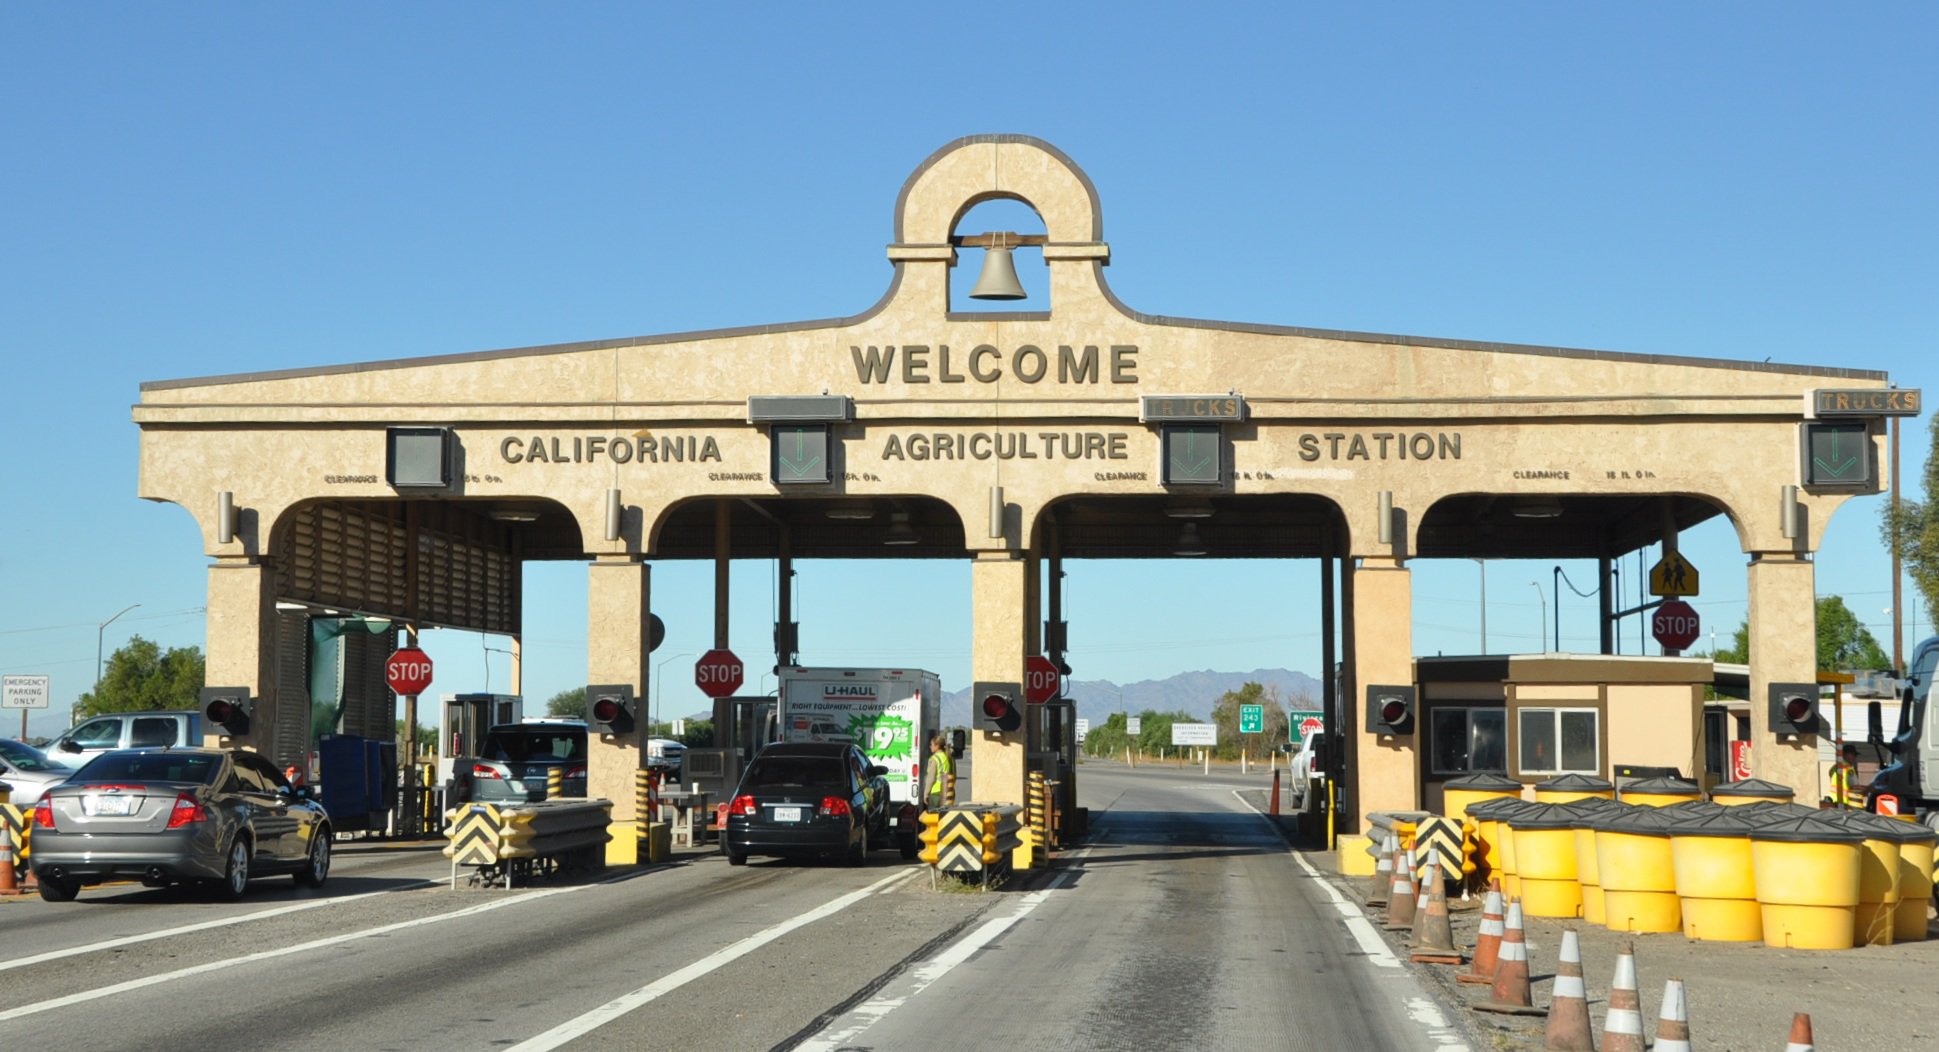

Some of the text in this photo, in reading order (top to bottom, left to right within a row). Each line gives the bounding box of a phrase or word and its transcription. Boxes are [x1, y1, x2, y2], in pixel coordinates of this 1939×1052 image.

[850, 344, 1138, 384] WELCOME
[1823, 392, 1917, 410] TRUCKS
[500, 432, 1461, 464] CALIFORNIA AGRICULTURE STATION
[708, 473, 764, 482] CLEARANCE
[1094, 472, 1147, 481] CLEARANCE
[1513, 470, 1570, 480] CLEARANCE
[1655, 616, 1697, 635] STOP
[388, 662, 431, 681] STOP
[698, 664, 741, 683] STOP
[4, 678, 46, 686] EMERGENCY
[1025, 671, 1056, 690] TOP
[824, 686, 876, 696] U-HAUL
[13, 697, 36, 705] ONLY
[792, 703, 812, 711] RIGHT
